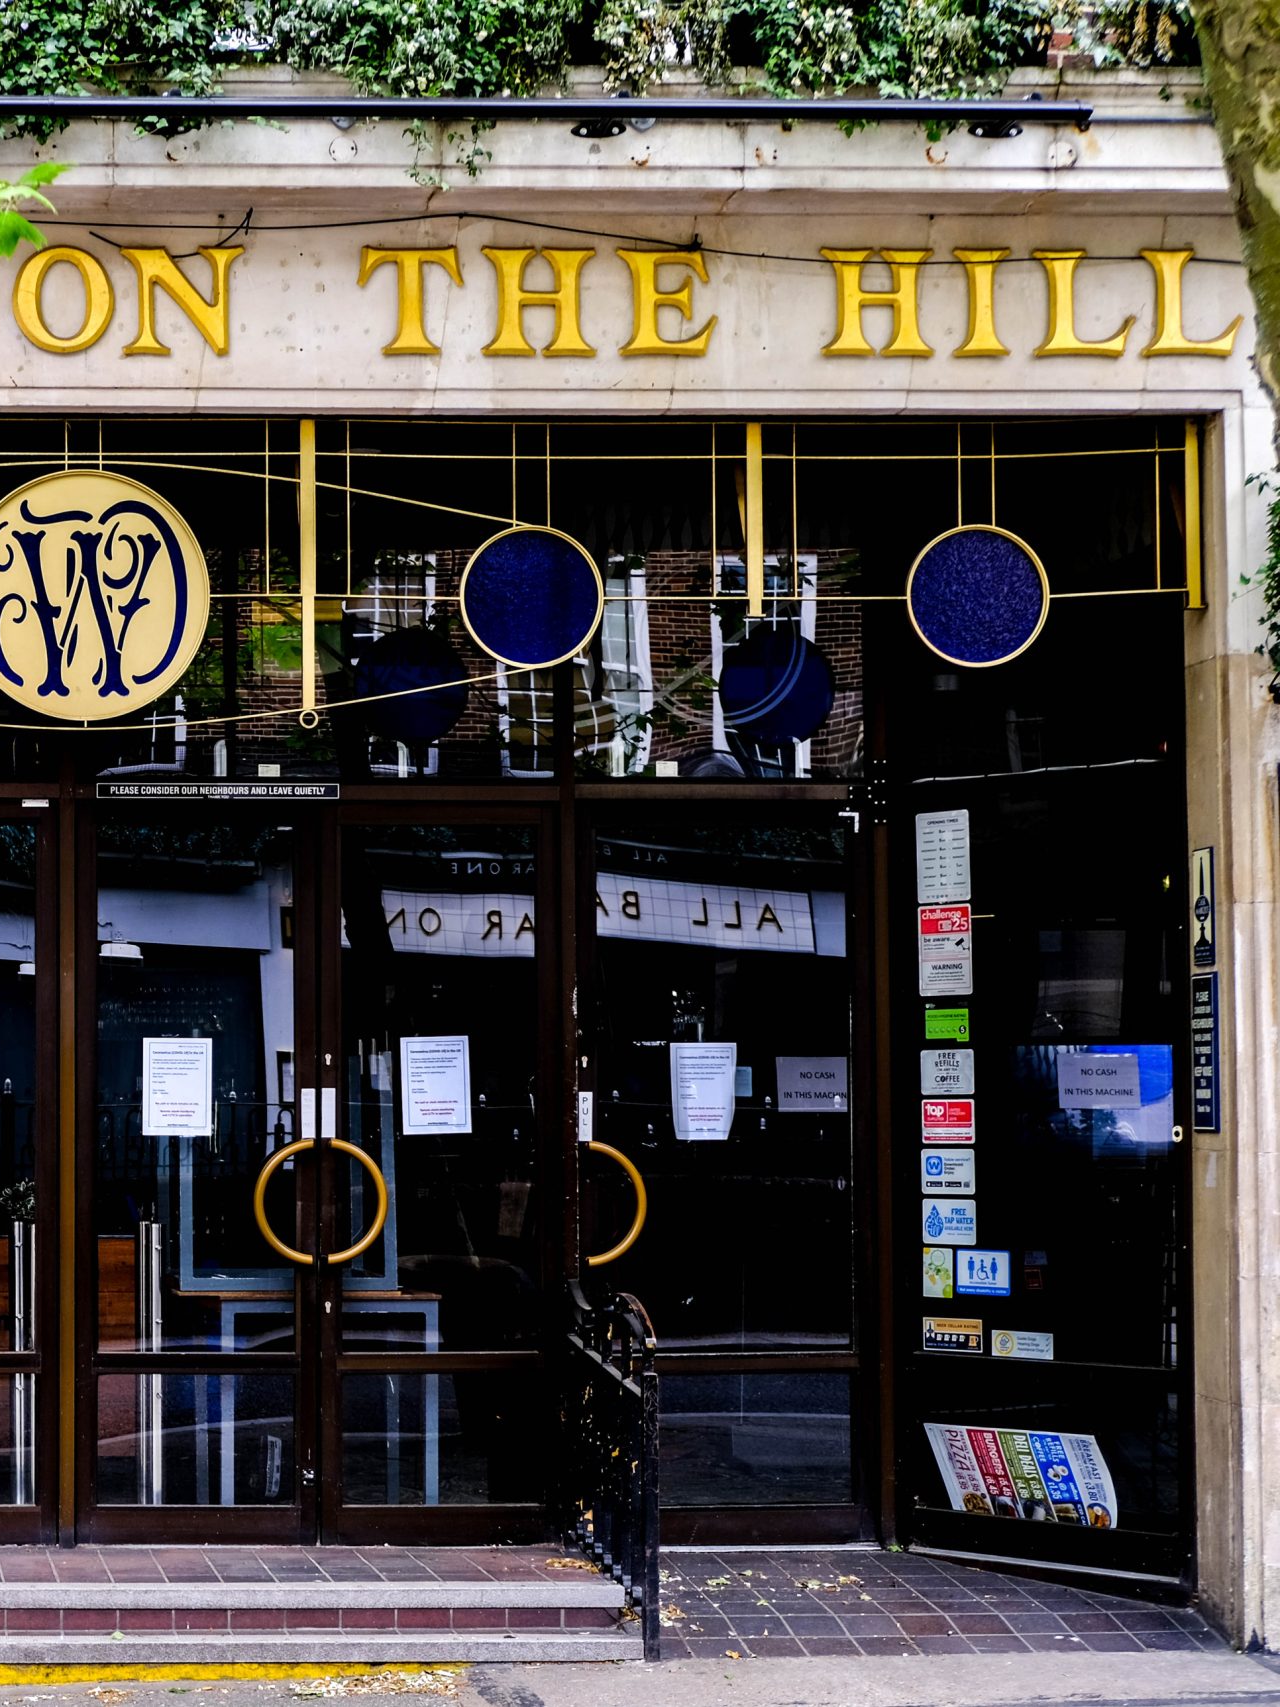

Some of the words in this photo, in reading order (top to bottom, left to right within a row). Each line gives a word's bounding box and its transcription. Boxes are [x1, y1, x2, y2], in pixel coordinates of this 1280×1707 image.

[12, 244, 245, 357] ON
[357, 244, 718, 357] THE
[821, 247, 1244, 359] HILL
[110, 786, 139, 795] PLEASE
[141, 786, 180, 795] CONSIDER
[181, 786, 198, 795] OUR
[199, 786, 249, 795] NEIGHBOURS
[250, 786, 267, 795] AND
[269, 787, 292, 795] LEAVE
[294, 787, 325, 796] QUIETLY
[922, 909, 962, 920] challenge
[931, 963, 963, 971] WARNING
[938, 1052, 957, 1060] FREE
[934, 1060, 960, 1068] REFILLS
[1080, 1068, 1094, 1076] NO
[1095, 1068, 1118, 1076] CASH
[934, 1075, 961, 1083] COFFEE
[783, 1091, 792, 1099] IN
[794, 1091, 812, 1099] THIS
[814, 1091, 847, 1099] MACHIN
[1075, 1088, 1094, 1096] THIS
[1095, 1088, 1135, 1097] MACHINE
[925, 1103, 945, 1118] top
[928, 1161, 940, 1170] W
[951, 1208, 967, 1216] FREE
[944, 1216, 955, 1224] TAP
[956, 1217, 974, 1225] WATER
[1013, 1434, 1030, 1453] DELI
[945, 1429, 971, 1472] PIZZA
[983, 1432, 1005, 1478] BURGERS
[1079, 1439, 1102, 1481] BREAKFAST
[1019, 1455, 1040, 1479] DEALS
